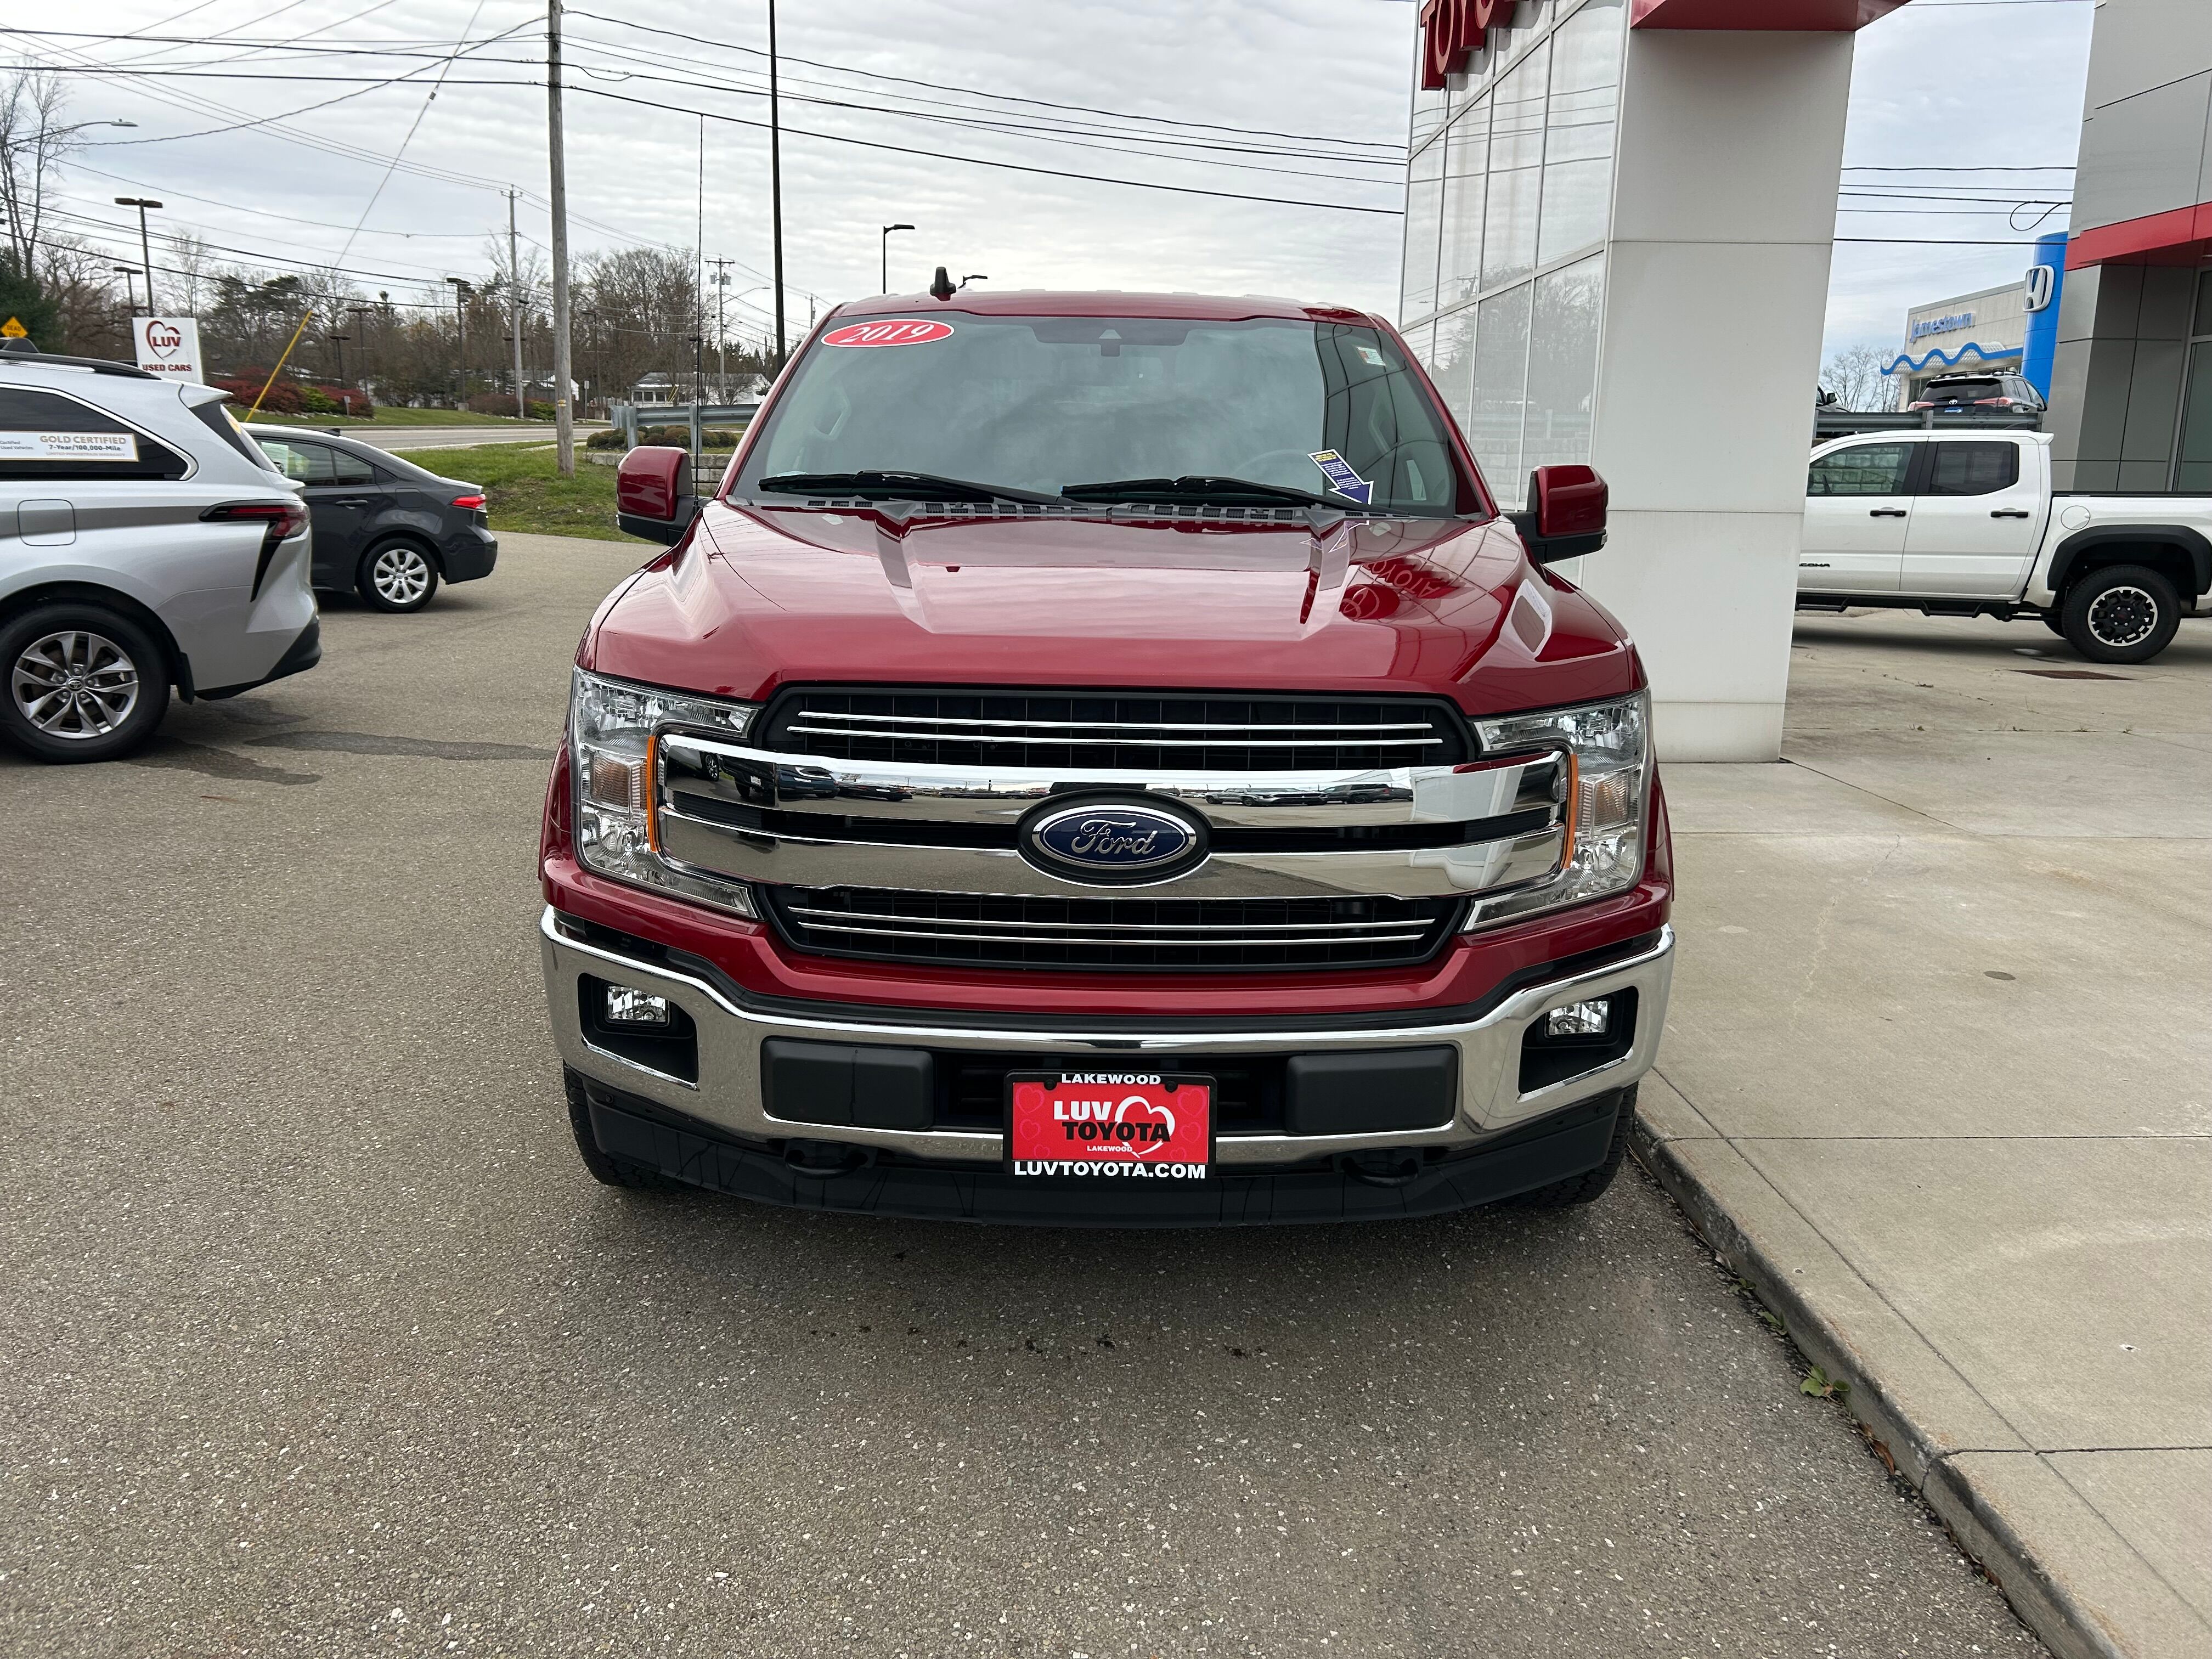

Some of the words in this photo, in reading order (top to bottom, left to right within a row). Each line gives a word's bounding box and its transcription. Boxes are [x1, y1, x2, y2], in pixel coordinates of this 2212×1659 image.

[837, 324, 935, 343] 2019
[1910, 312, 1973, 343] Jamestown
[152, 336, 182, 347] LUV
[167, 364, 193, 372] CARS
[39, 435, 71, 444] GOLD
[73, 436, 127, 445] CERTIFIED
[1071, 819, 1159, 855] Ford
[1061, 1073, 1161, 1085] LAKEWOOD
[1053, 1101, 1113, 1121] LUV
[1062, 1121, 1171, 1142] TOYOTA
[1014, 1161, 1206, 1179] LUVTOYOTA.COM
